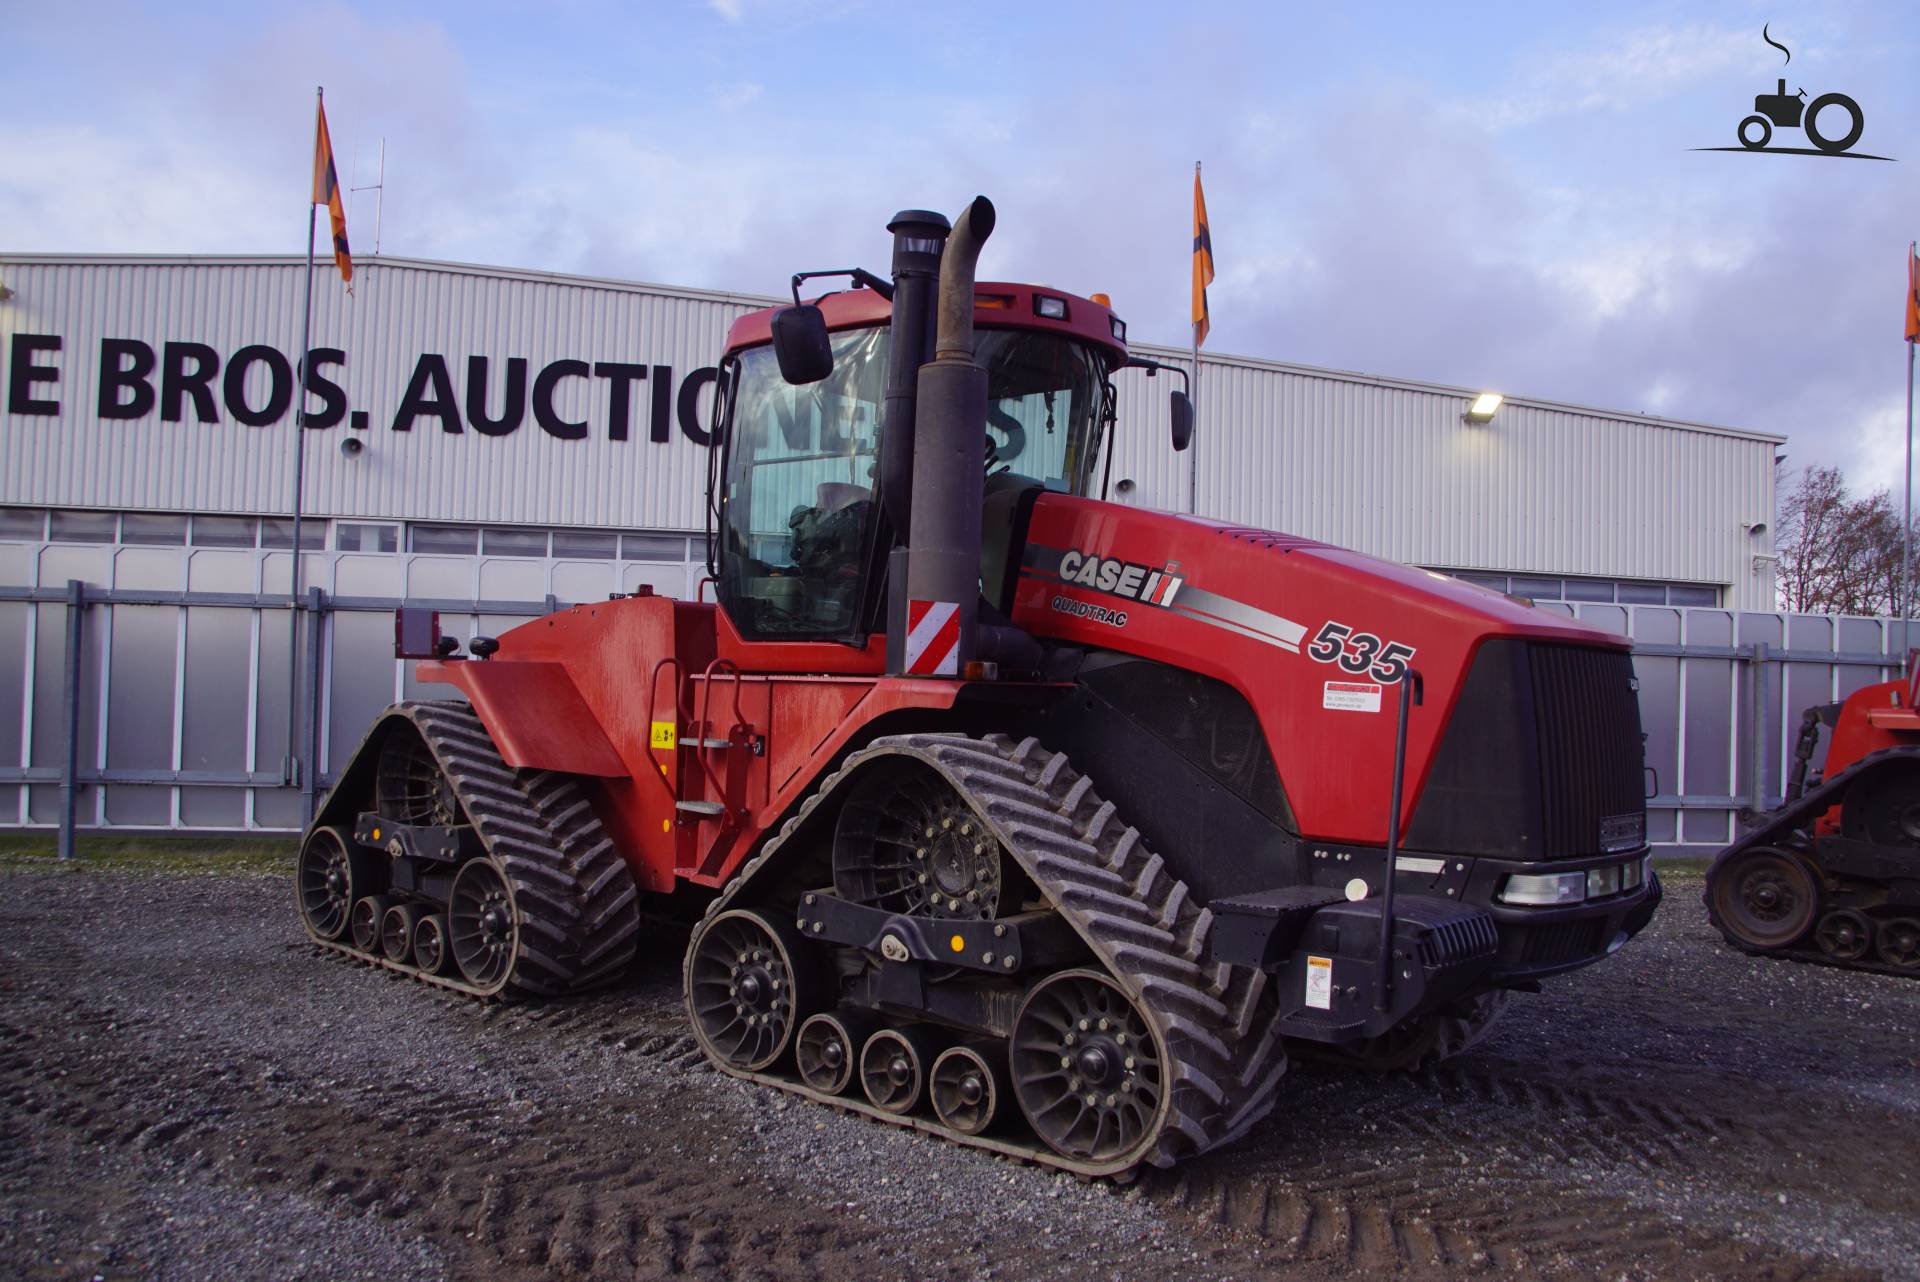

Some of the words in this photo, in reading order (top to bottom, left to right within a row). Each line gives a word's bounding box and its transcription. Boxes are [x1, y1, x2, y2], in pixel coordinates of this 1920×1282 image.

[98, 338, 368, 429] BROS.
[1060, 550, 1147, 598] CASE
[1051, 596, 1128, 628] QUADTRAC
[1307, 620, 1416, 685] 535
